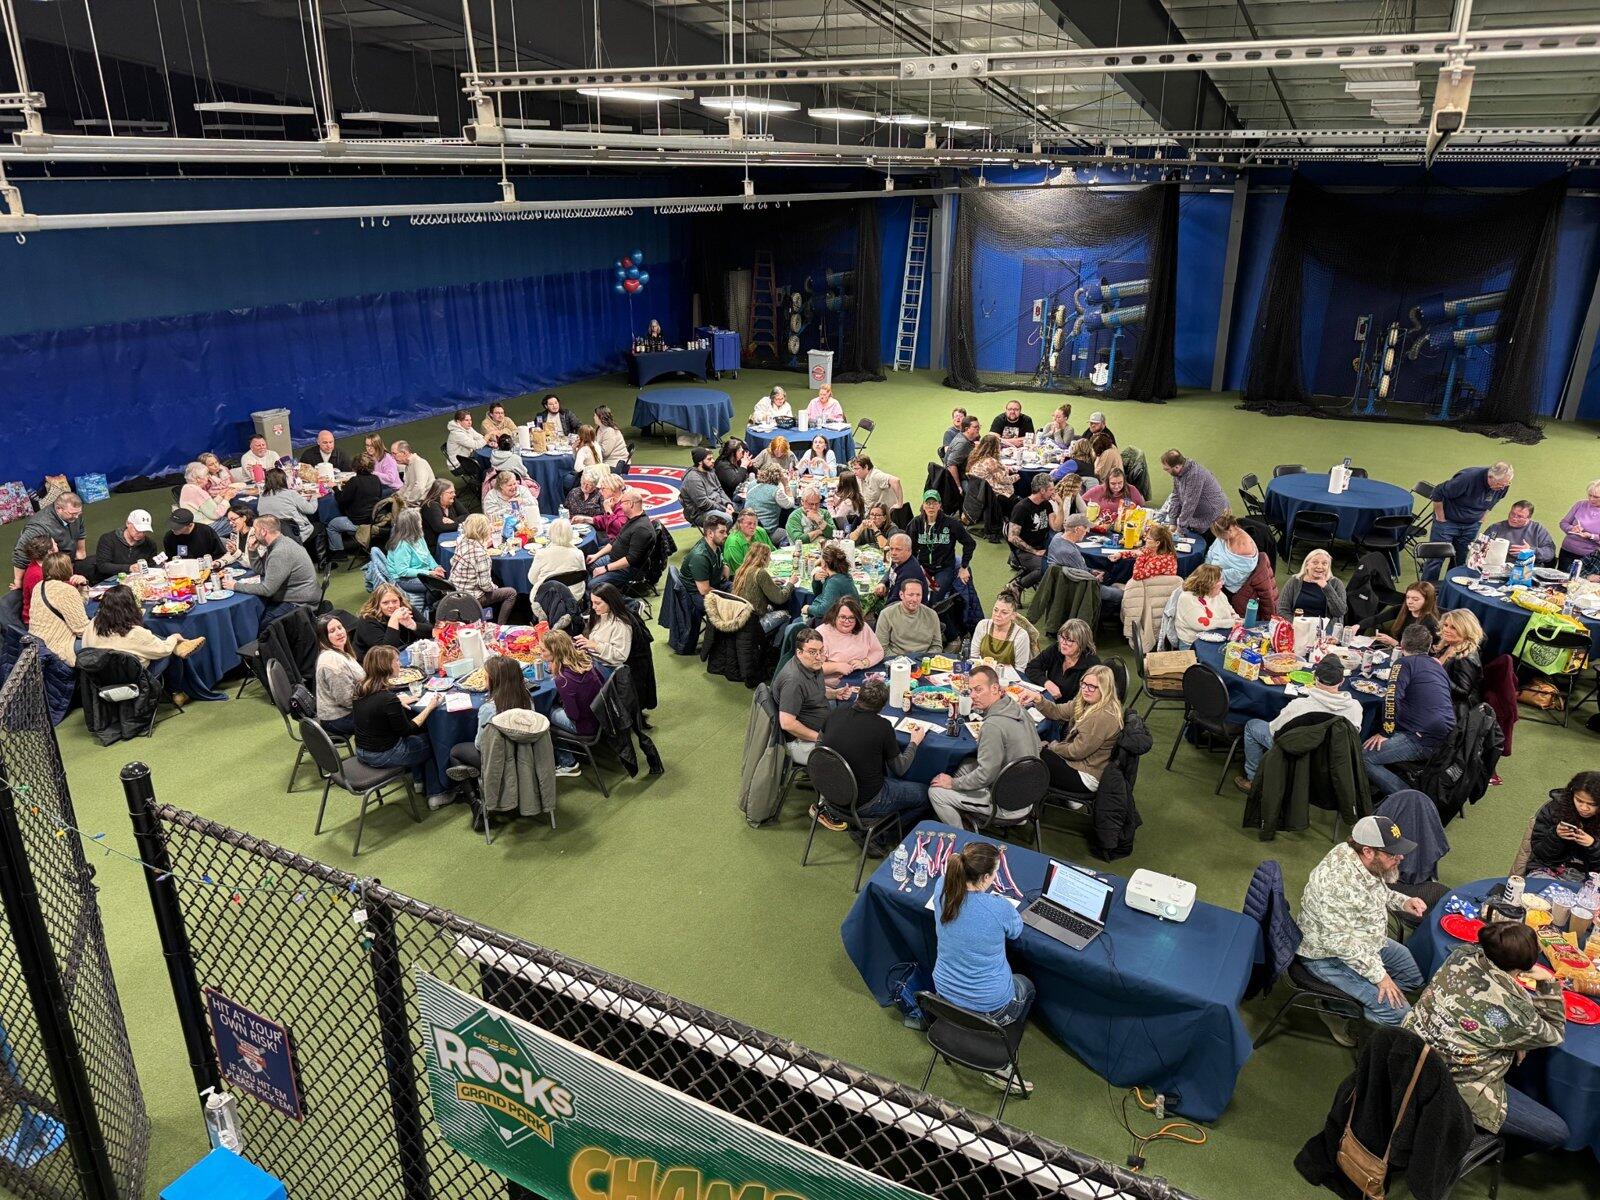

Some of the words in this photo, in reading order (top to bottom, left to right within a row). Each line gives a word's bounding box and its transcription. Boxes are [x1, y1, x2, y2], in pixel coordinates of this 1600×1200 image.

[1385, 684, 1396, 719] FIGHTING
[1443, 994, 1458, 1011] YOU
[212, 998, 230, 1016] HIT
[234, 1011, 246, 1024] AT
[248, 1018, 282, 1044] YOUR
[220, 1013, 248, 1037] OWN
[250, 1030, 278, 1054] RISK!
[226, 1068, 256, 1092] PLEASE
[258, 1086, 275, 1103] PICK
[228, 1062, 236, 1071] IF
[238, 1065, 256, 1082] YOU
[258, 1078, 270, 1090] HIT
[461, 1086, 507, 1109] GRAND
[508, 1103, 546, 1136] PARK
